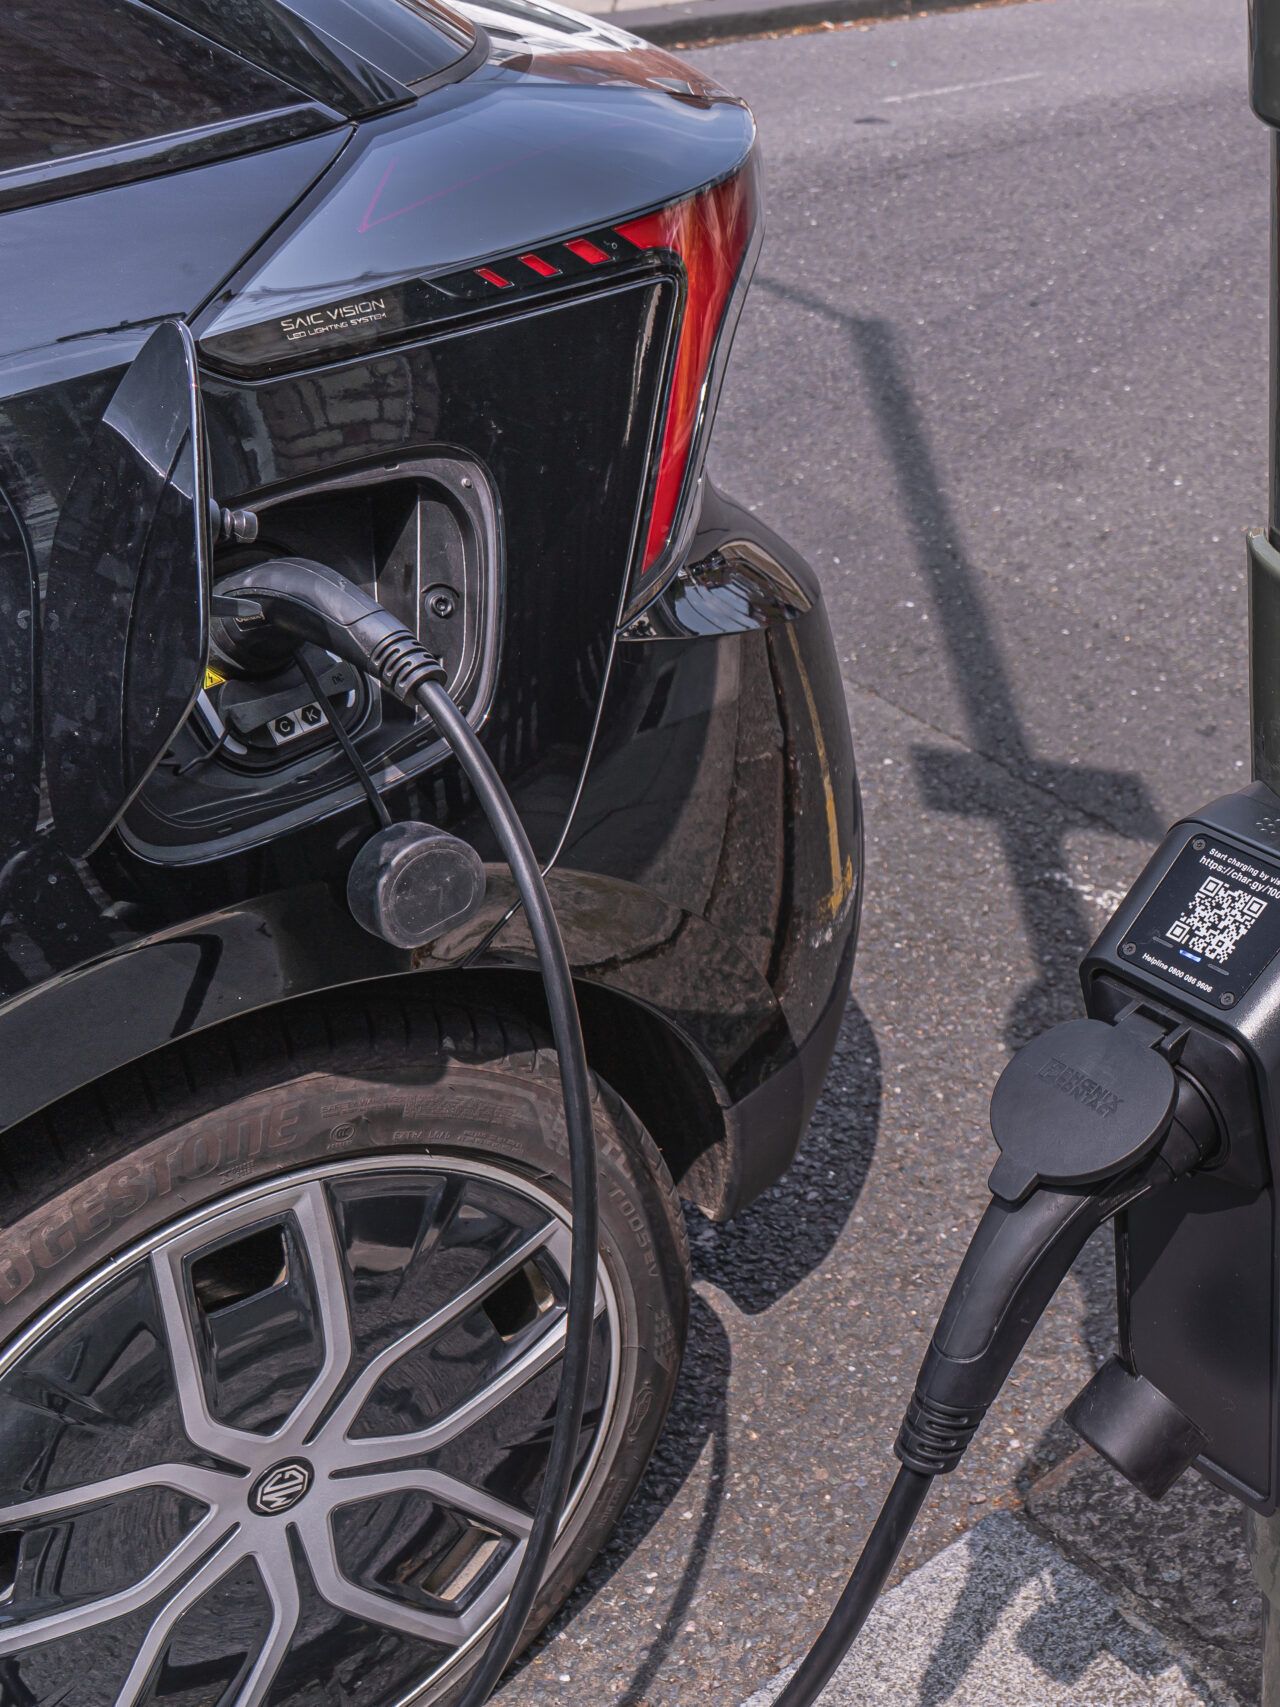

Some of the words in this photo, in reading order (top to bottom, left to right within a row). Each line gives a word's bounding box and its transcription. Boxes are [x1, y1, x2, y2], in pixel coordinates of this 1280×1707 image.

[281, 312, 324, 332] SAIC
[326, 298, 386, 320] VISION
[286, 331, 307, 341] LED
[307, 321, 349, 336] LIGHTING
[350, 312, 387, 327] SYSTEM
[279, 720, 291, 732] C
[305, 708, 319, 722] K
[1209, 848, 1229, 861] Start
[1227, 857, 1260, 877] charging
[1259, 871, 1270, 881] by
[1142, 952, 1169, 970] Helpline
[1168, 966, 1185, 978] 0800
[260, 1467, 306, 1510] MG
